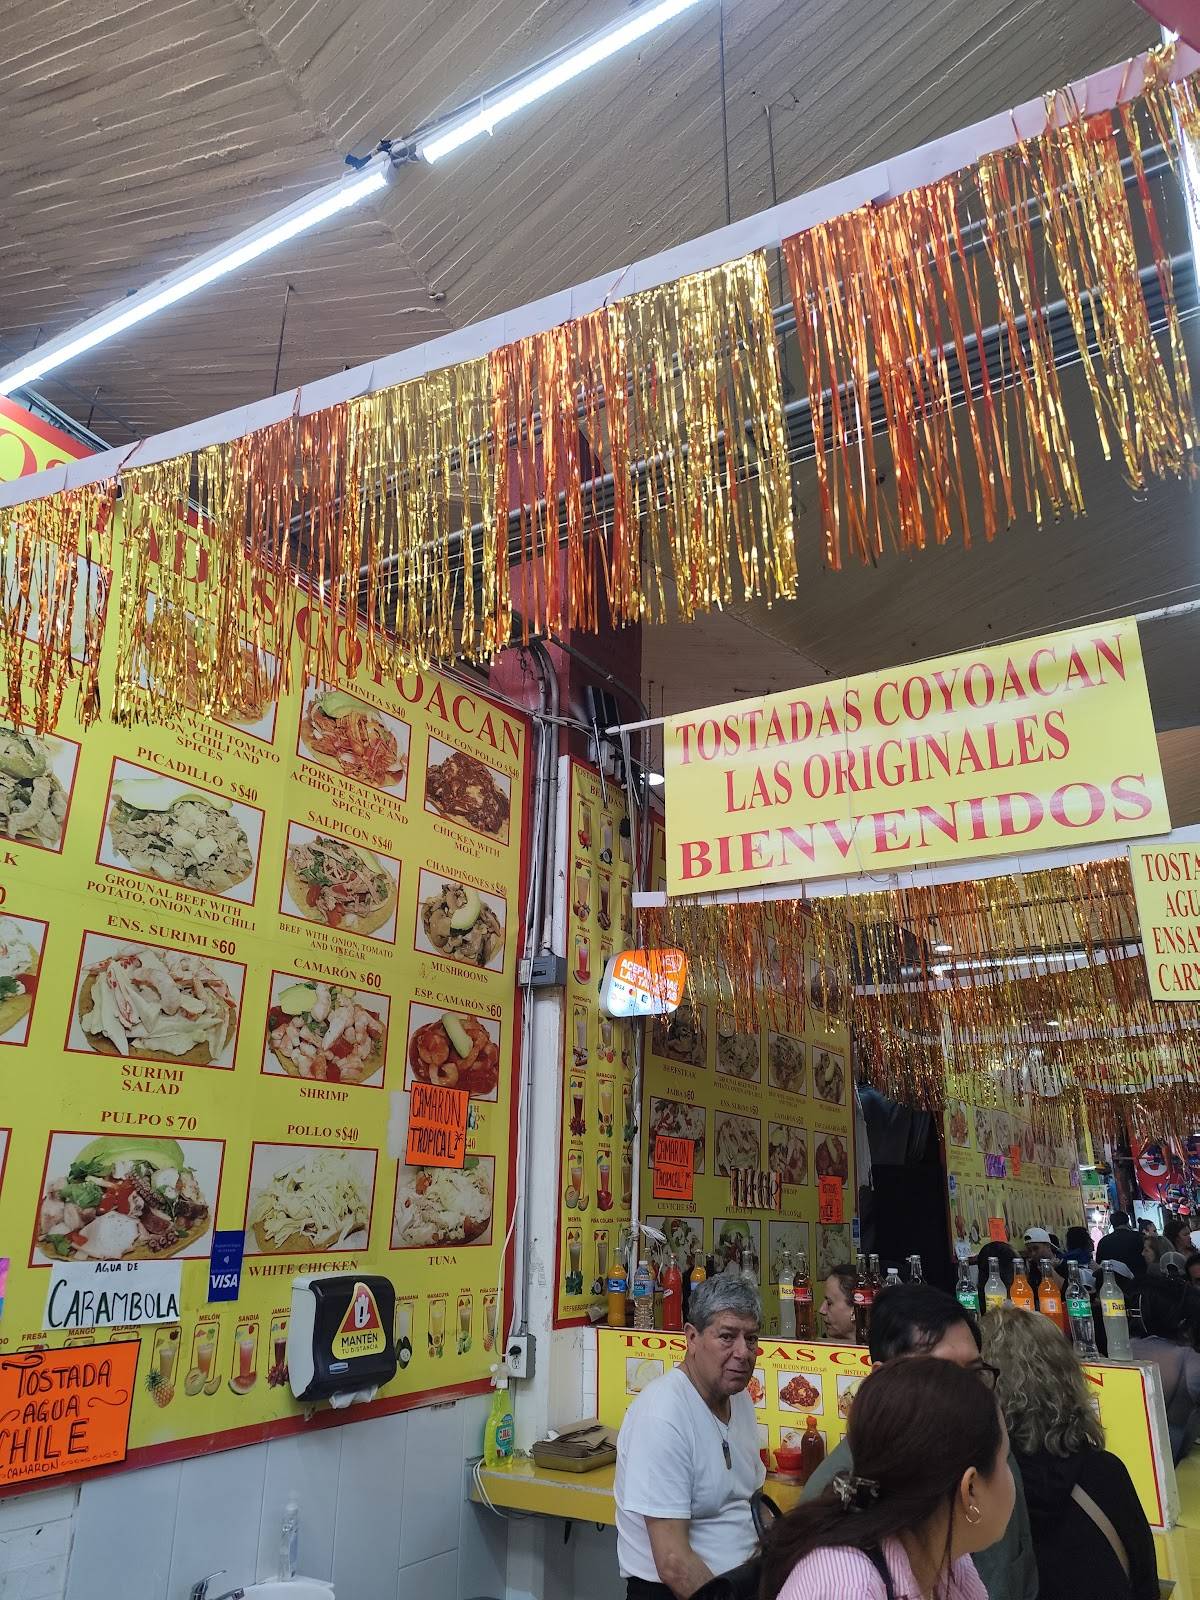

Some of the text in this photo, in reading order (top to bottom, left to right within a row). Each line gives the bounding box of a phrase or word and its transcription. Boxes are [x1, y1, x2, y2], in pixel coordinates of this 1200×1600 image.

[338, 677, 383, 707] CHINITA
[676, 633, 1127, 766] TOSTADAS COYOACAN
[176, 735, 223, 761] SPICES
[187, 717, 281, 765] WITH TOMATO
[192, 729, 230, 754] CHILI
[233, 745, 260, 766] AND
[425, 722, 450, 741] MOLE
[454, 737, 474, 752] CON
[475, 748, 503, 768] POLLO
[137, 747, 224, 787] PICADILLO
[724, 710, 1070, 813] LAS ORIGINALES
[290, 771, 409, 825] ACHIOTE SAUCE AND
[301, 763, 402, 811] PORK MEAT WITH
[331, 798, 371, 820] SPICES
[308, 811, 370, 841] SALPICON
[433, 823, 501, 857] CHICKEN WITH
[678, 773, 1153, 880] BIENVENIDOS
[454, 841, 481, 859] MOLE
[86, 880, 257, 931] POTATO, ONION AND CHILI
[105, 873, 242, 917] GROUNAL BEEF WITH
[107, 914, 237, 956] ENS. SURIMI $60
[279, 922, 302, 935] BEEF
[305, 928, 329, 942] WITH
[310, 940, 329, 951] AND
[360, 971, 381, 988] $60
[430, 961, 488, 984] MUSHROOMS
[414, 987, 434, 1000] ESP.
[486, 1004, 502, 1018] $60
[121, 1064, 184, 1082] SURIMI
[122, 1079, 180, 1095] SALAD
[299, 1087, 349, 1102] SHRIMP
[100, 1110, 162, 1127] PULPO
[287, 1124, 332, 1138] POLLO
[410, 1127, 456, 1159] TROPICAL
[95, 1262, 139, 1273] AGUA DE
[249, 1259, 359, 1277] WHITE CHICKEN
[428, 1255, 458, 1266] TUNA
[210, 1273, 238, 1289] VISA
[48, 1279, 180, 1328] CARAMBOLA
[21, 1332, 48, 1342] FRESA
[67, 1327, 97, 1337] MANGO
[341, 1330, 378, 1348] MANTÉN
[2, 1354, 113, 1399] TOSTADA
[22, 1395, 80, 1425] AGUA
